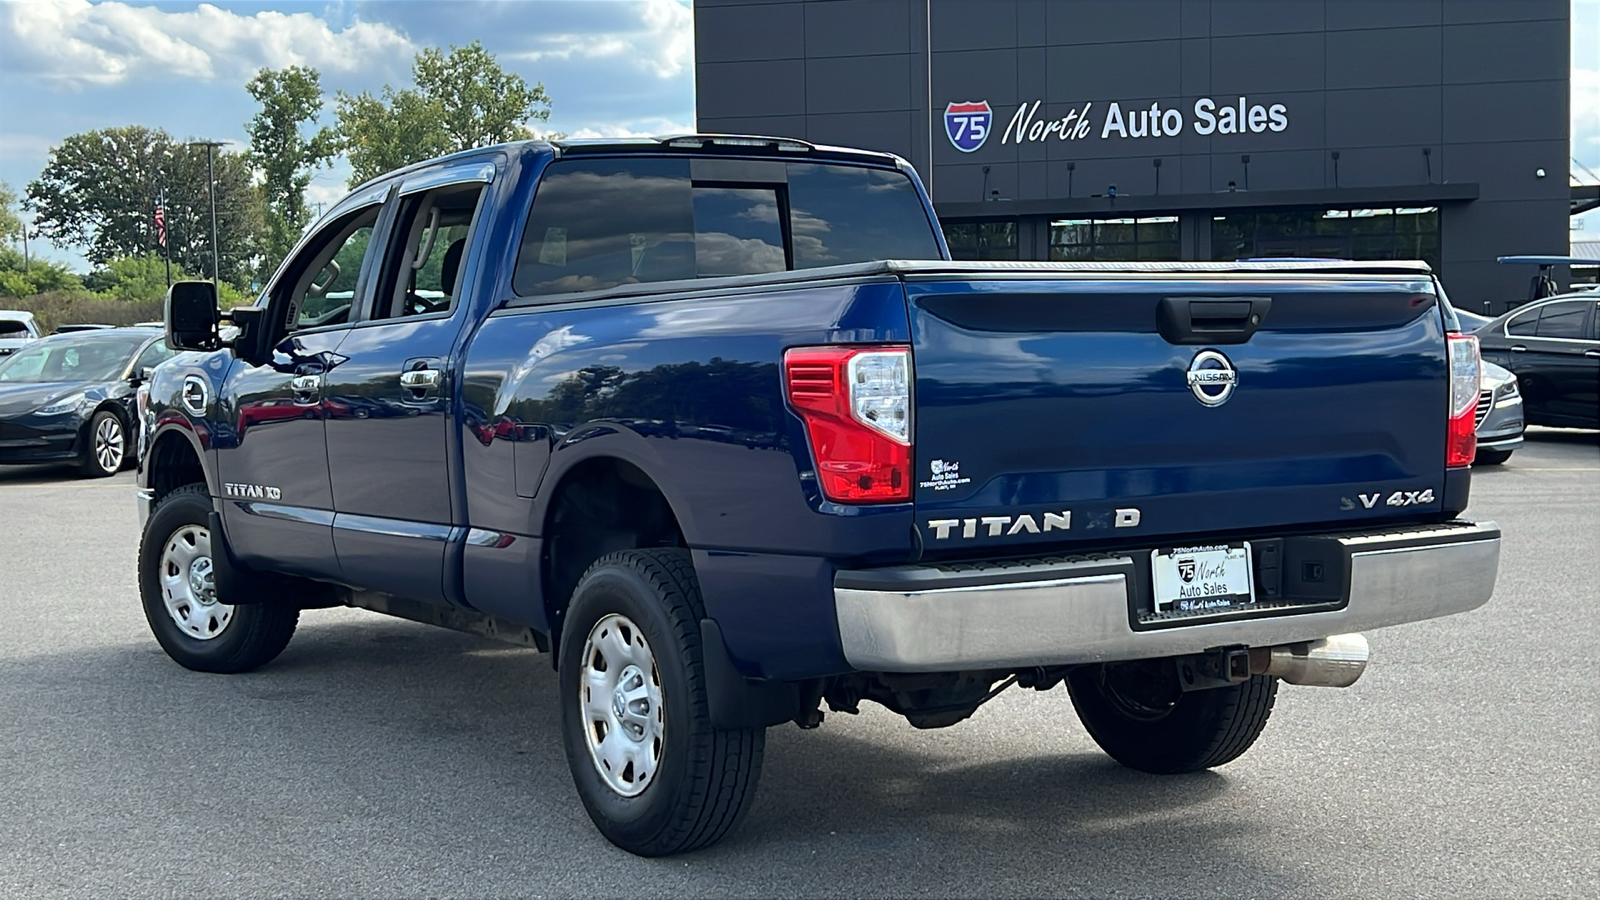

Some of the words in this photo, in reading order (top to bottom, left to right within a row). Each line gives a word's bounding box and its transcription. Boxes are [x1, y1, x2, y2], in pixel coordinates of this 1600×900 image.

[953, 116, 985, 141] 75
[1001, 99, 1092, 145] North
[1101, 101, 1183, 138] Auto
[1193, 97, 1289, 136] Sales
[1194, 372, 1234, 382] NISSAN
[224, 482, 264, 498] TITAN
[265, 486, 281, 500] XD
[927, 510, 1072, 540] TITAN
[1180, 565, 1194, 579] 75
[1196, 561, 1226, 581] North
[1179, 585, 1201, 598] Auto
[1203, 582, 1228, 595] Sales
